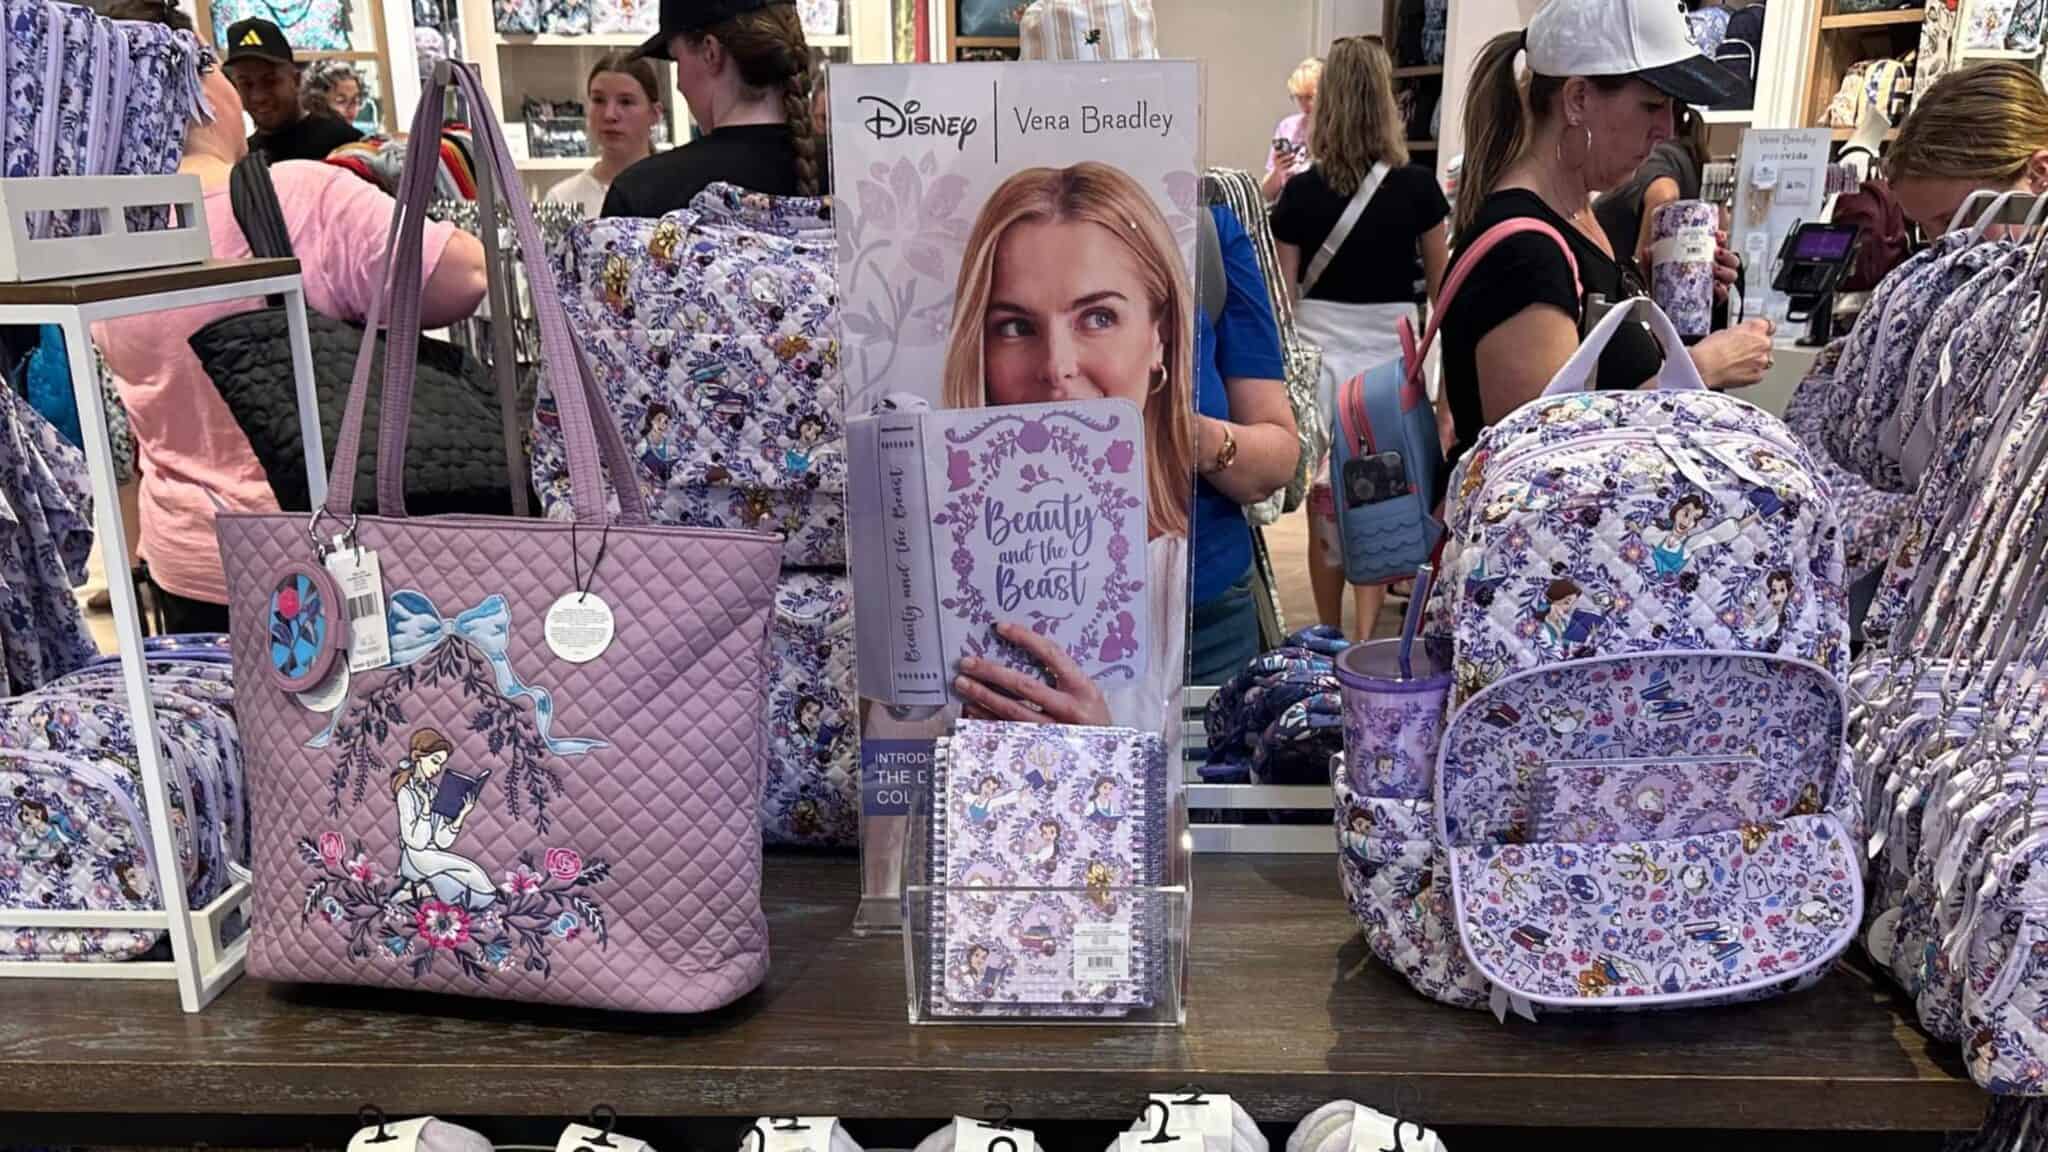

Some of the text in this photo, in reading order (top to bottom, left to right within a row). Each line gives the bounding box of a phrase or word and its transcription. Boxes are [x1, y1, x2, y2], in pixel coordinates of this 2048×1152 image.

[857, 96, 977, 151] Disney
[1013, 100, 1173, 136] Vera Bradley
[985, 493, 1098, 556] Beauty
[889, 465, 925, 662] Beauty and the Beast
[999, 536, 1068, 566] and the
[996, 561, 1090, 612] Beast
[875, 752, 928, 764] INTROD
[876, 770, 911, 784] THE
[877, 790, 912, 804] COL
